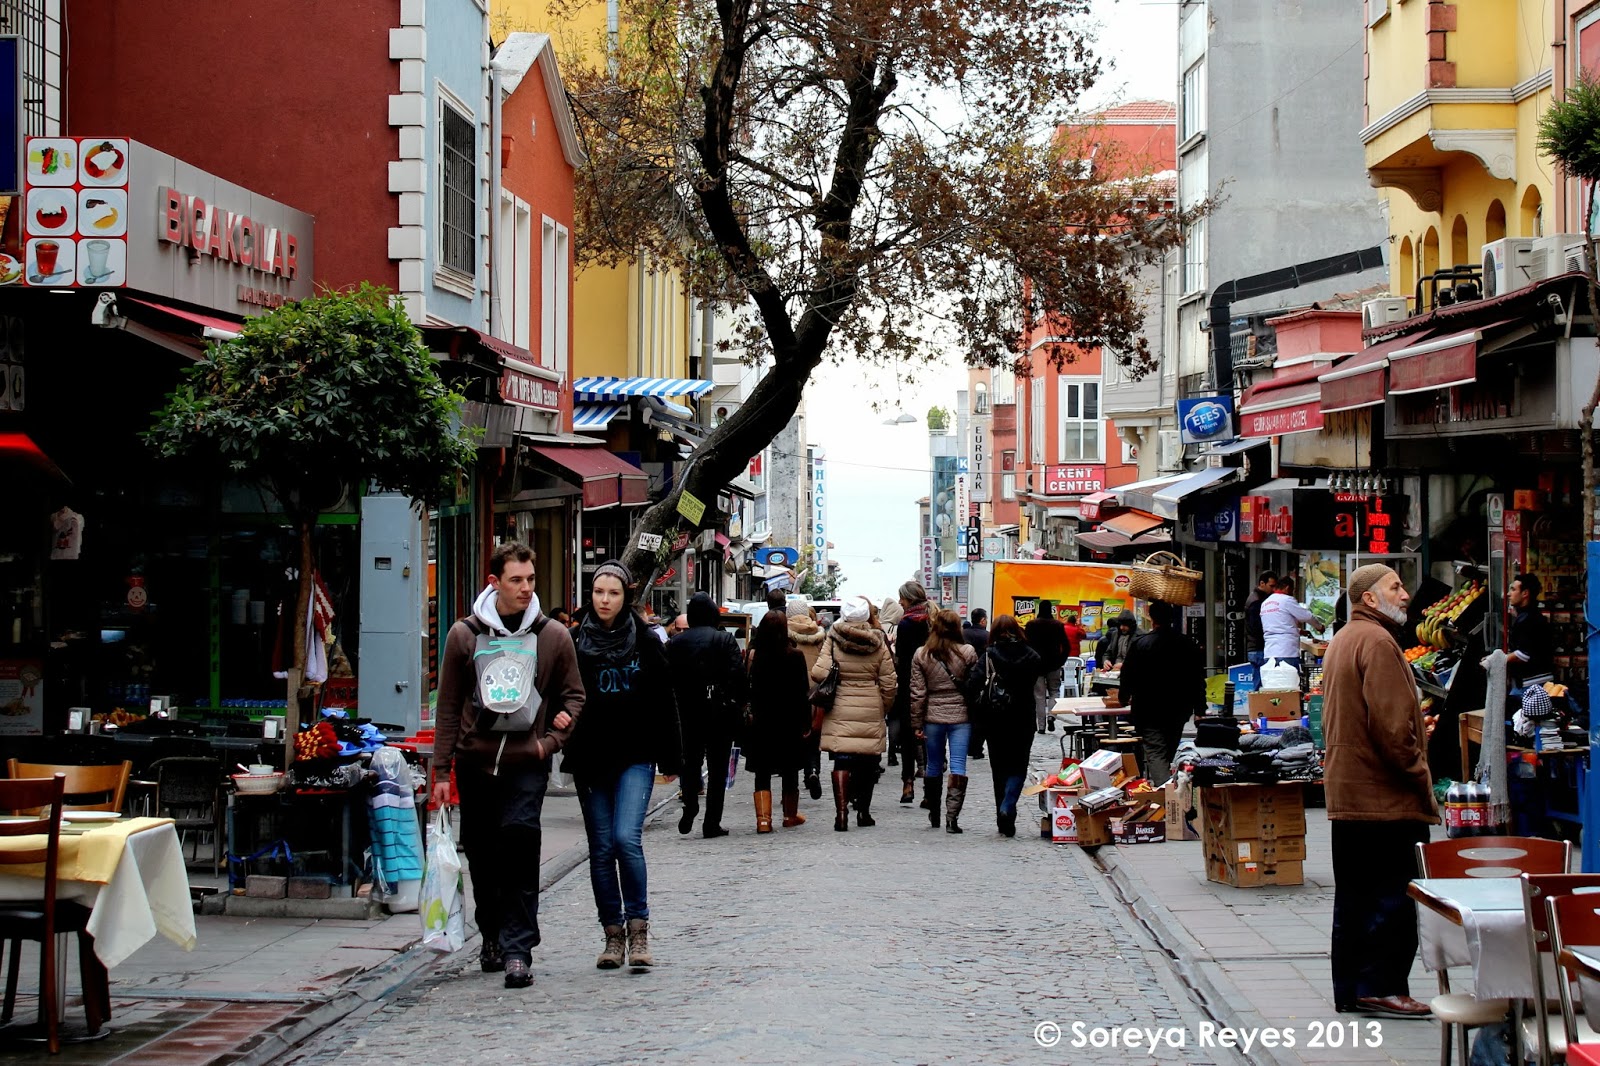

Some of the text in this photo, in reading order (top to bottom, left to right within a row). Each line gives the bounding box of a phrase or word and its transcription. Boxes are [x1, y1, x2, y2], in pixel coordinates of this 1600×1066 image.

[1192, 408, 1220, 427] EFES
[1199, 421, 1218, 432] Pilsen
[1057, 468, 1093, 478] KENT
[1049, 480, 1101, 491] CENTER
[1227, 565, 1236, 606] FABIO
